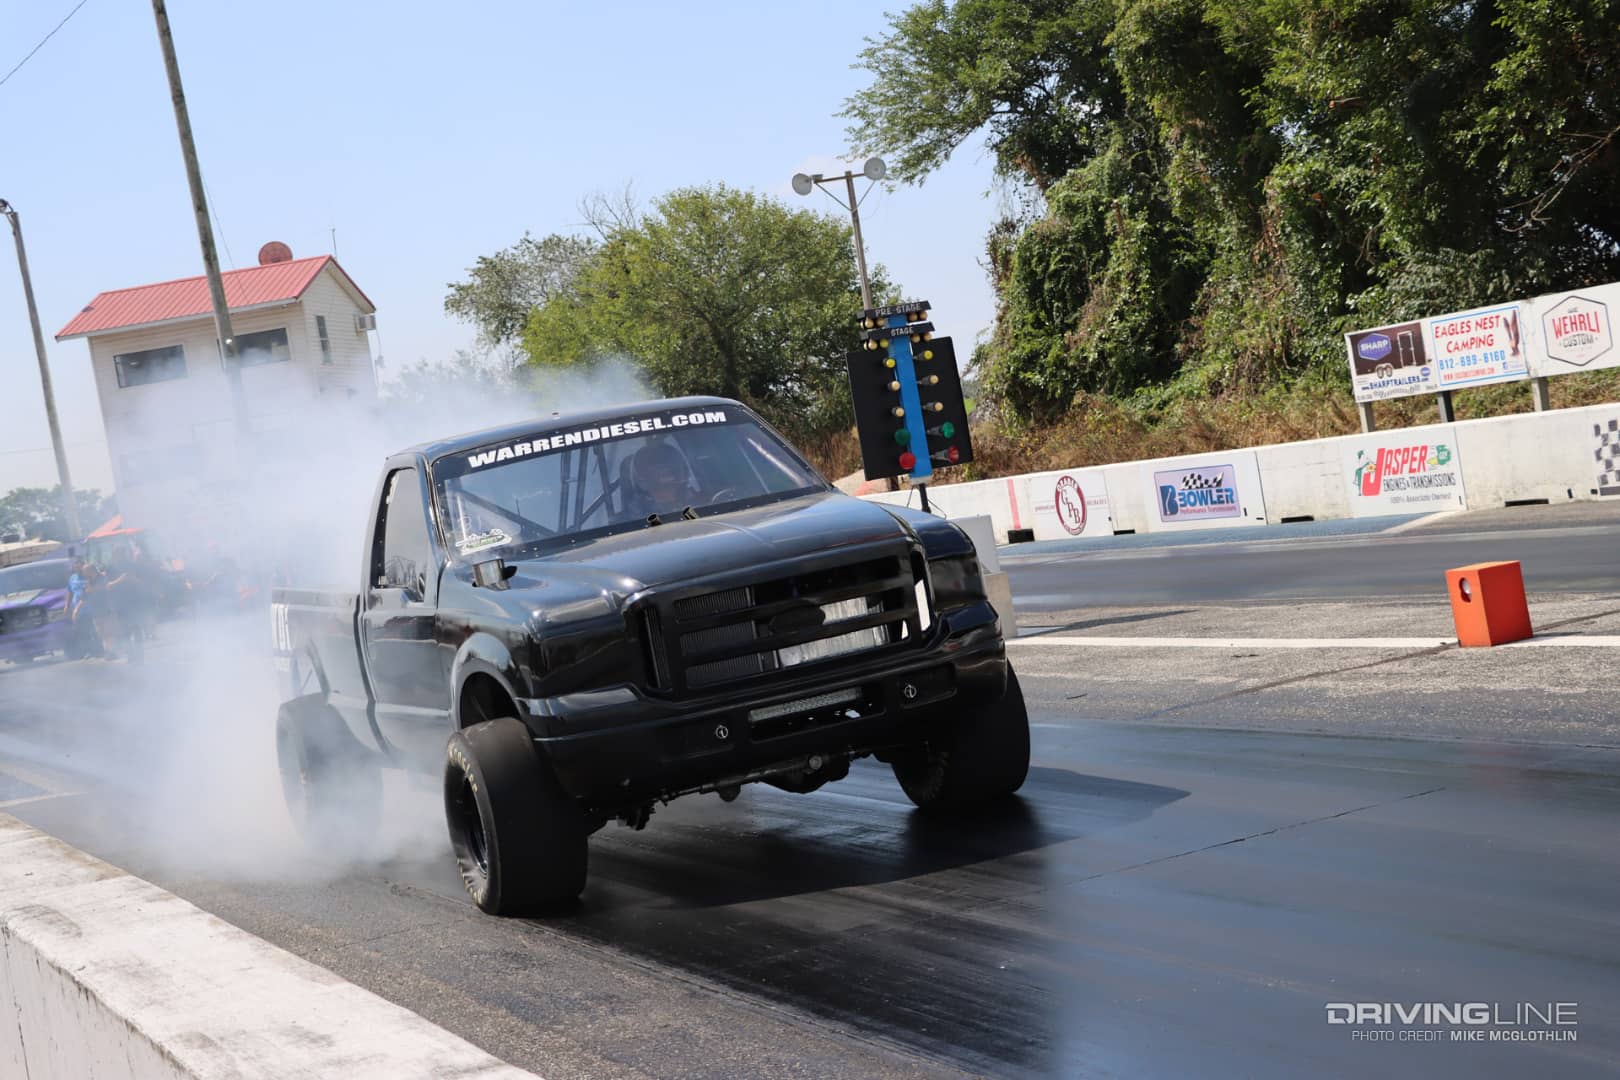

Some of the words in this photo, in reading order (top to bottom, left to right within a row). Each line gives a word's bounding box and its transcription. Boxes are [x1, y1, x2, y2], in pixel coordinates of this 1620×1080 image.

[875, 309, 891, 317] PRE
[896, 303, 920, 313] STAGE
[890, 327, 914, 336] STAGE
[1435, 320, 1471, 338] EAGLES
[1475, 315, 1500, 330] NEST
[1552, 311, 1600, 339] WEHRLI
[1360, 340, 1388, 352] SHARP
[1446, 334, 1494, 353] CAMPING
[1563, 333, 1594, 348] CUSTOM
[468, 411, 727, 468] WARRENDIESEL.COM
[1362, 445, 1428, 496] JASPER
[1384, 478, 1407, 492] ENGINES
[1409, 472, 1456, 489] TRANSMISSIONS
[1178, 487, 1235, 507] BOWLER
